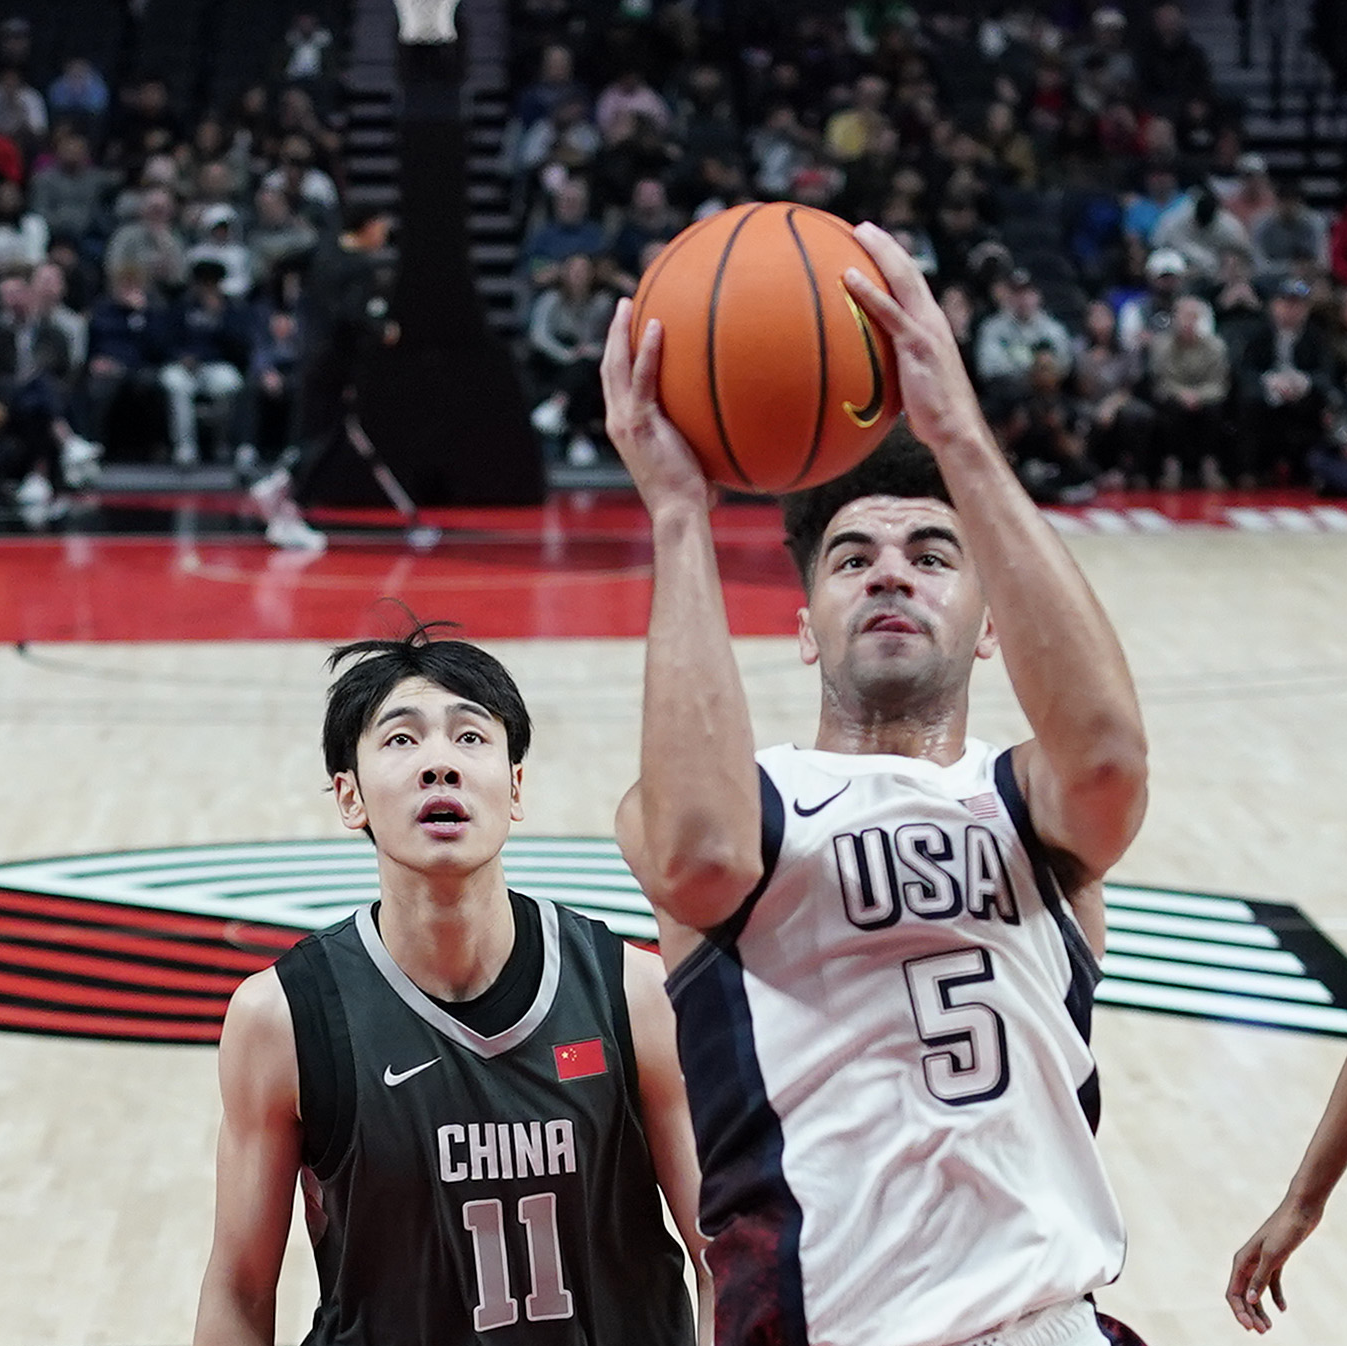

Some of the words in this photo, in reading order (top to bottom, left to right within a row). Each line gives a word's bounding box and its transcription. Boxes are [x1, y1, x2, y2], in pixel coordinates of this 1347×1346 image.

[833, 823, 1020, 931] USA
[902, 946, 1009, 1106] 5
[437, 1119, 577, 1183] CHINA
[462, 1192, 574, 1333] 11
